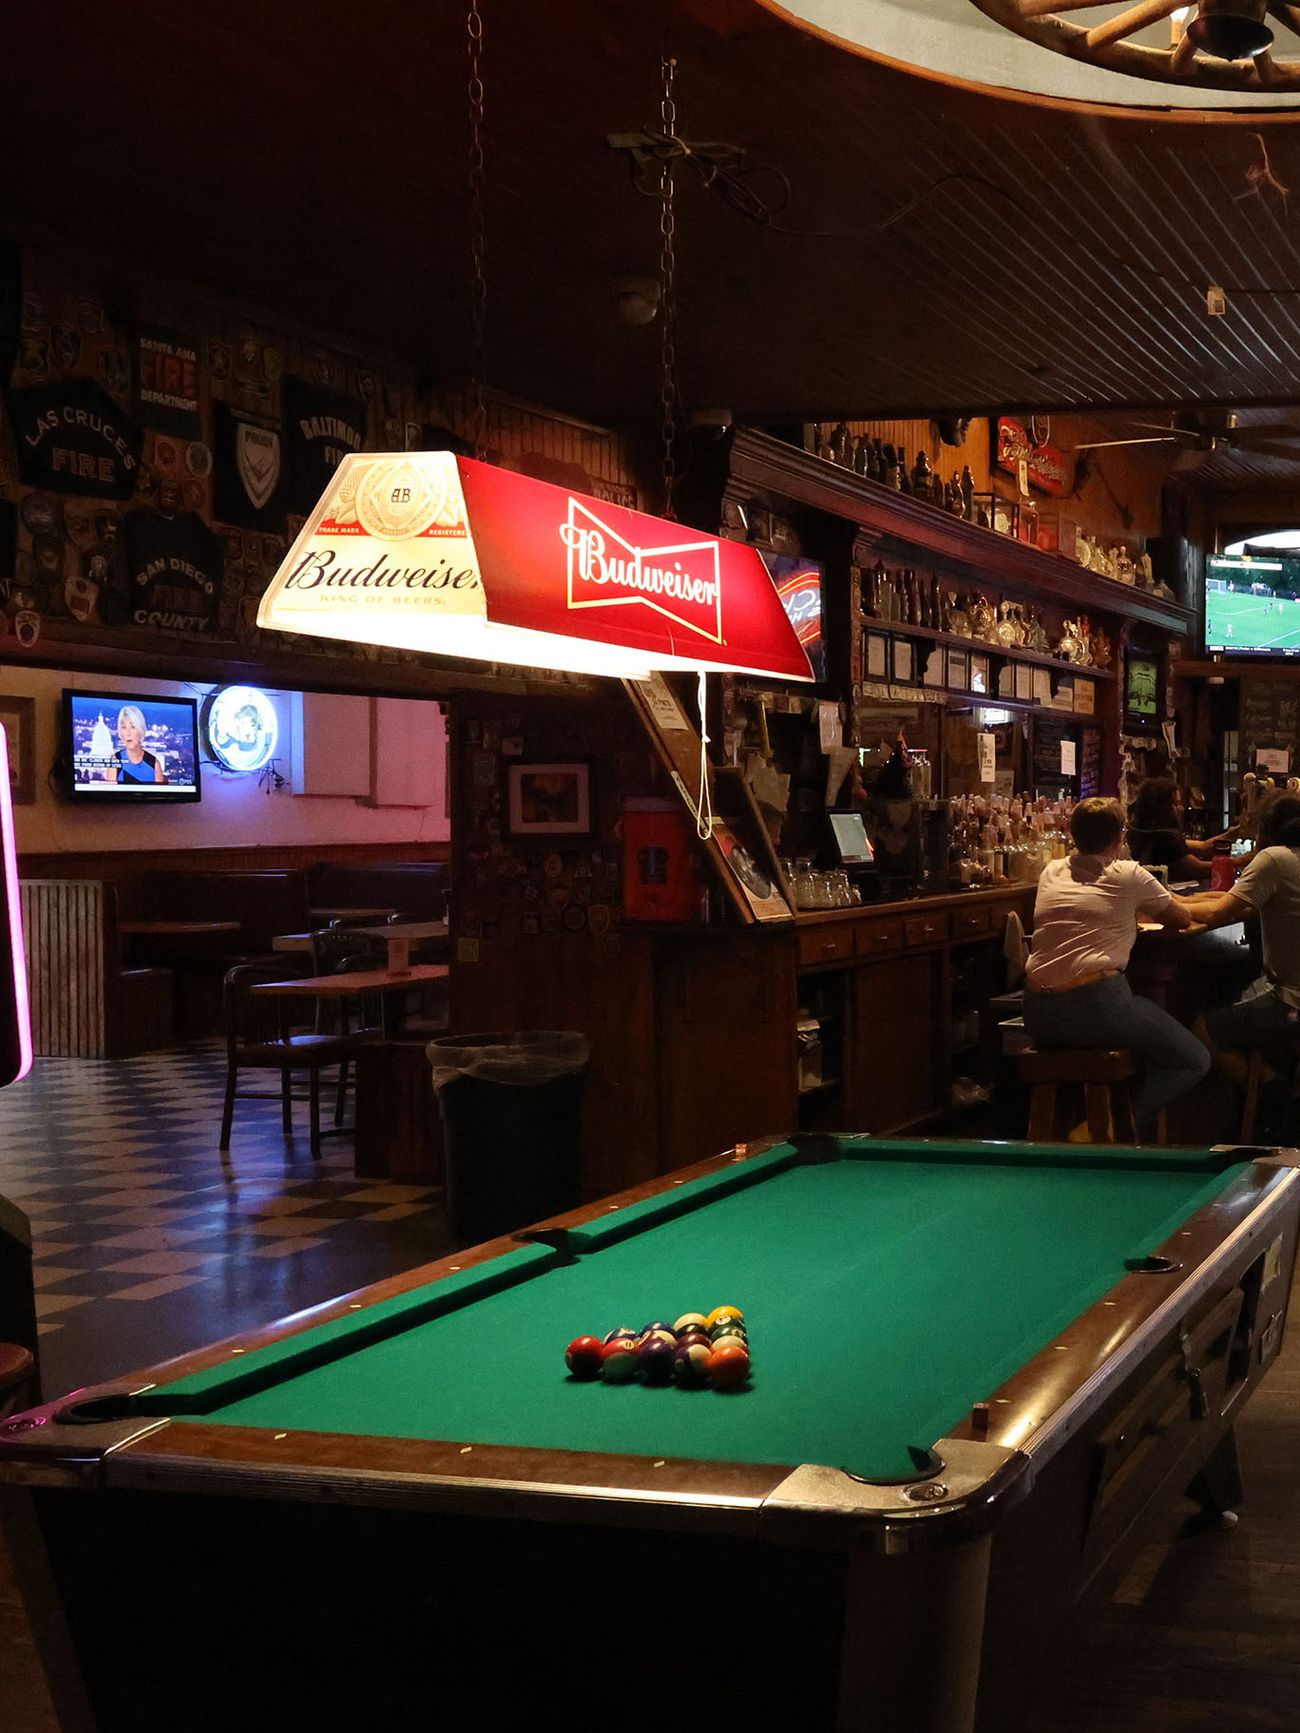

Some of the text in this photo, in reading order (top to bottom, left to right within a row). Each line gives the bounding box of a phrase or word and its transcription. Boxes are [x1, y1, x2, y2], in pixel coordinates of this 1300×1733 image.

[140, 352, 196, 397] FIRE
[25, 406, 136, 471] LAS CRUCES
[51, 446, 115, 484] FIRE
[317, 526, 339, 534] TRADE
[428, 528, 468, 537] REGISTERE
[136, 557, 214, 595] SAN DIEGO
[559, 523, 720, 606] Budweiser
[320, 593, 359, 604] KING
[365, 594, 385, 604] OF
[133, 608, 210, 631] COUNTY
